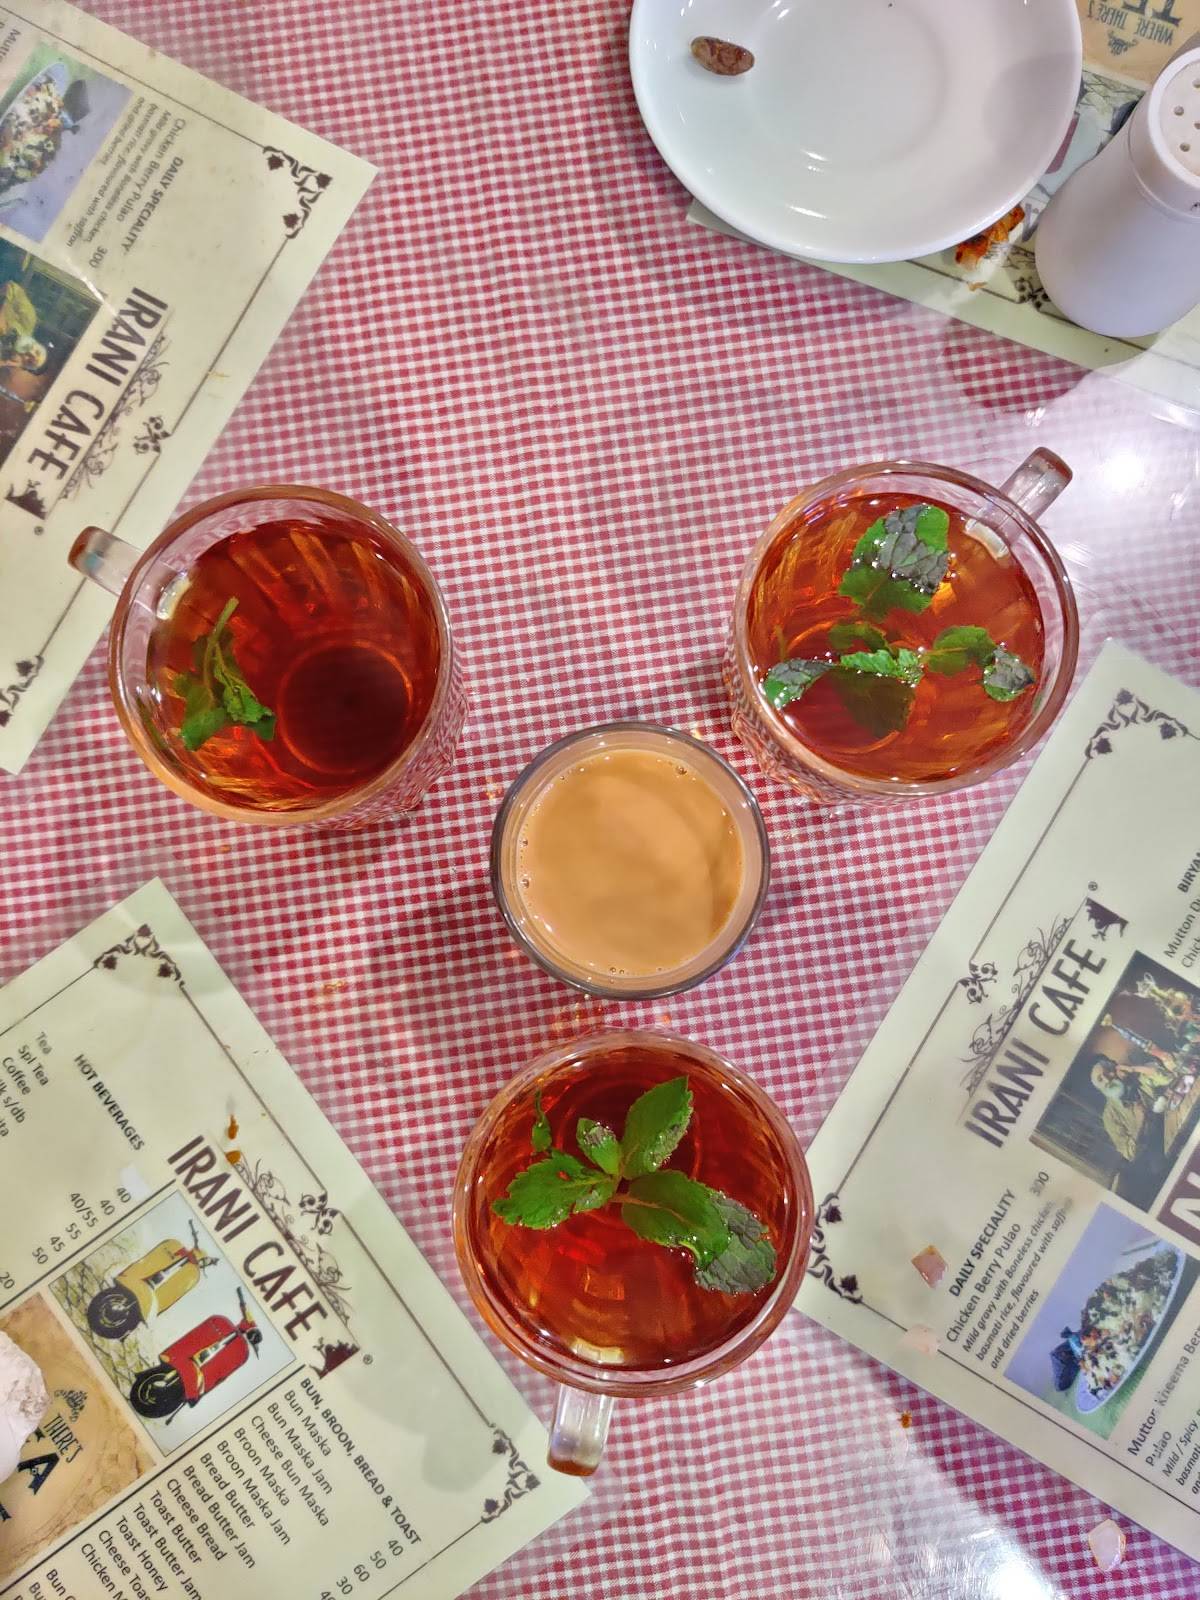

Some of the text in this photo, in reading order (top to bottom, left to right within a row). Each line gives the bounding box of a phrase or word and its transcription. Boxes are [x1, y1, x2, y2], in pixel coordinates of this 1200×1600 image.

[1134, 18, 1174, 46] WHERE
[119, 113, 135, 137] dried
[132, 97, 145, 115] and
[129, 155, 143, 174] with
[140, 128, 158, 154] gravy
[86, 197, 100, 216] with
[89, 118, 186, 268] Chicken Berry Pulao 300
[105, 174, 132, 211] Boneless
[121, 157, 184, 252] DAILY SPECIALITY
[67, 217, 88, 247] saffron
[27, 287, 168, 480] IRANI CAFE
[1164, 914, 1196, 958] Mutton
[18, 1045, 49, 1086] Spl Tea
[36, 1031, 52, 1055] Tea
[964, 939, 1107, 1148] IRANI CAFE
[3, 1057, 31, 1095] Coffee
[75, 1054, 144, 1150] HOT BEVERAGES
[3, 1096, 26, 1123] s/db
[70, 1193, 98, 1227] 40/55
[100, 1200, 115, 1215] 40
[117, 1188, 131, 1203] 40
[32, 1247, 48, 1264] 50
[50, 1237, 65, 1252] 45
[66, 1222, 81, 1240] 55
[167, 1135, 328, 1341] IRANI CAFE
[949, 1189, 1015, 1297] DAILY SPECIALITY
[946, 1295, 980, 1342] Chicken
[974, 1259, 1002, 1293] Berry
[994, 1224, 1021, 1258] Pulao
[962, 1327, 980, 1352] Mild
[977, 1301, 997, 1331] gravy
[993, 1279, 1009, 1300] with
[1005, 1237, 1033, 1279] Boneless
[975, 1320, 1002, 1361] basmati
[1000, 1302, 1016, 1321] rice,
[1010, 1252, 1041, 1303] flavoured
[1038, 1232, 1054, 1253] with
[991, 1289, 1039, 1369] and dried berries
[43, 1413, 83, 1463] THERE'S
[300, 1378, 421, 1544] BUN, BROON, BREAD & TOAST
[1162, 1451, 1180, 1477] Mild
[1179, 1420, 1198, 1446] Spicy
[200, 1452, 255, 1528] Bread Butter
[217, 1440, 245, 1479] Broon
[242, 1478, 273, 1519] Maska
[270, 1519, 290, 1545] Jam
[251, 1416, 370, 1582] Cheese Bun Maska 60
[267, 1402, 387, 1569] Bun Maska Jam 50
[284, 1390, 403, 1556] Bun Maska 40
[133, 1502, 159, 1539] Toast
[154, 1537, 185, 1576] Butter
[150, 1490, 202, 1563] Toast Butter
[167, 1479, 228, 1561] Cheese Bread
[183, 1465, 255, 1569] Bread Butter Jam
[234, 1427, 353, 1595] Broon Maska 30
[81, 1543, 115, 1592] Chicken
[99, 1530, 131, 1576] Cheese
[116, 1515, 168, 1591] Toast Honey
[46, 1569, 66, 1596] Bun
